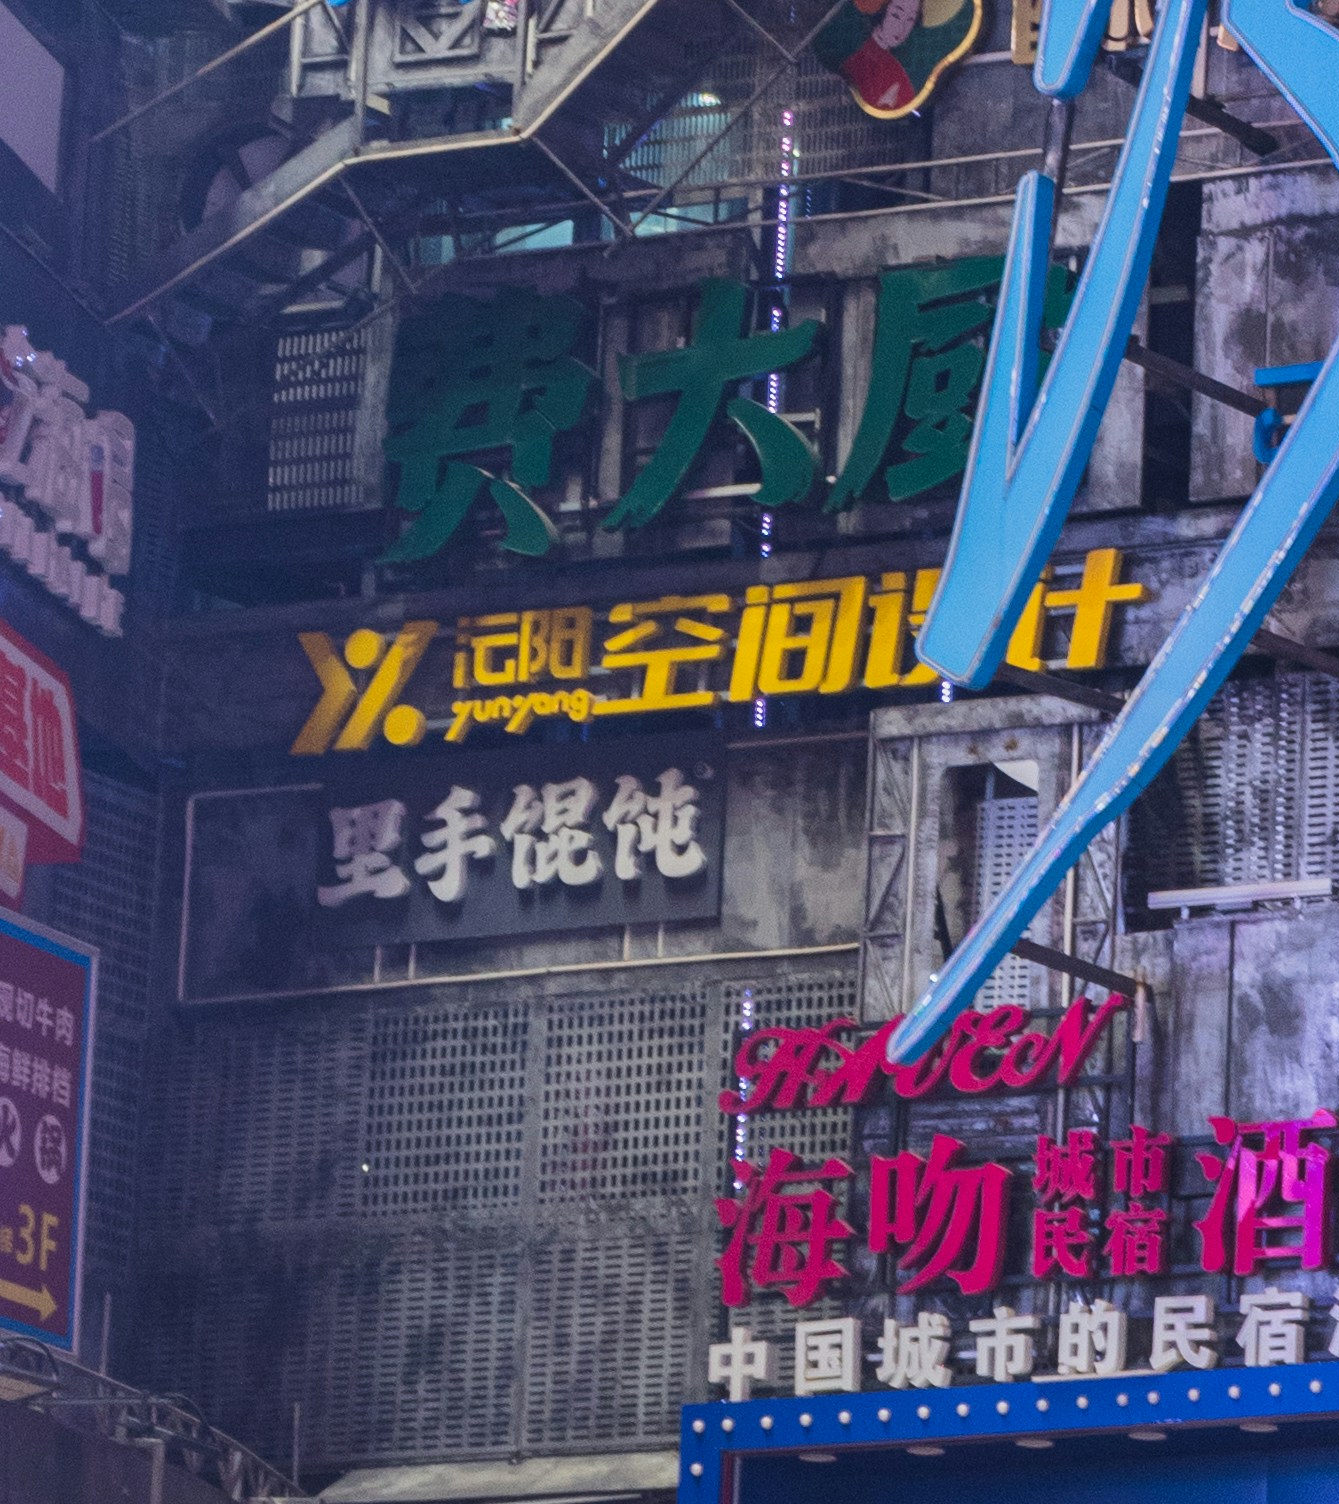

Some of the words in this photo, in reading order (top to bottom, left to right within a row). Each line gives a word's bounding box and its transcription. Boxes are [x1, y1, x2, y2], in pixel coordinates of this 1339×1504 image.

[444, 689, 594, 742] yunyang
[16, 1204, 59, 1271] 3F
[714, 1133, 1011, 1307] 海吻
[1032, 1126, 1170, 1203] 城市
[1032, 1204, 1167, 1279] 民宿
